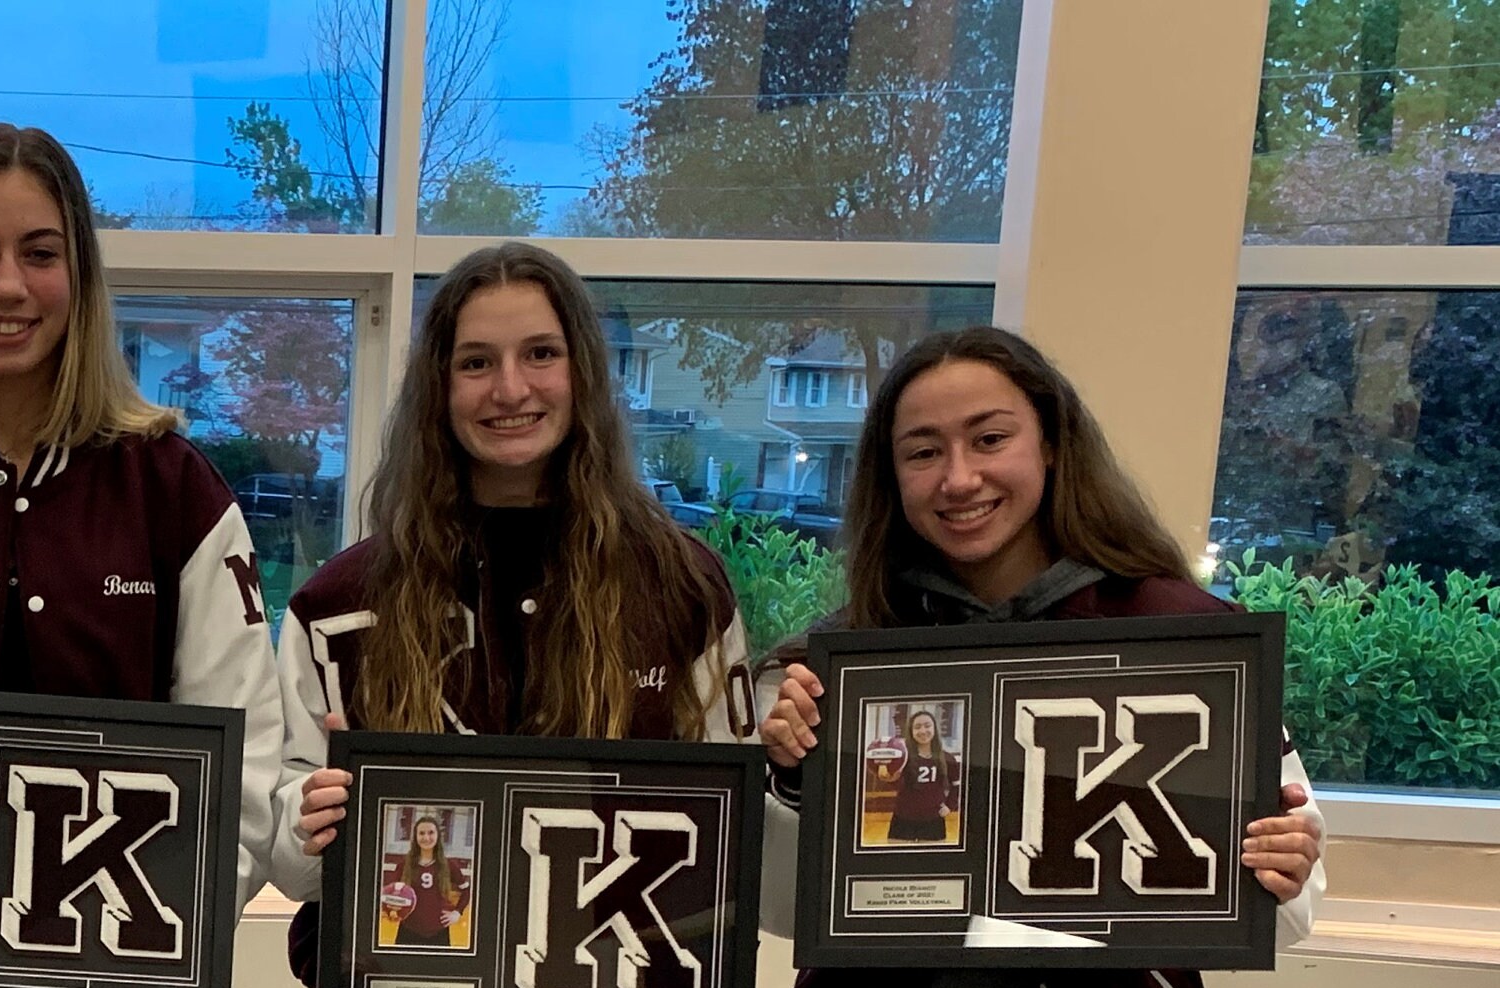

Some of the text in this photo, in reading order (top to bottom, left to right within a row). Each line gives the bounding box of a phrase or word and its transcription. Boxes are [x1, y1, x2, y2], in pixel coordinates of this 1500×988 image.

[917, 766, 937, 782] 21
[1008, 693, 1217, 895] K
[0, 764, 183, 960] K
[421, 873, 433, 888] 9
